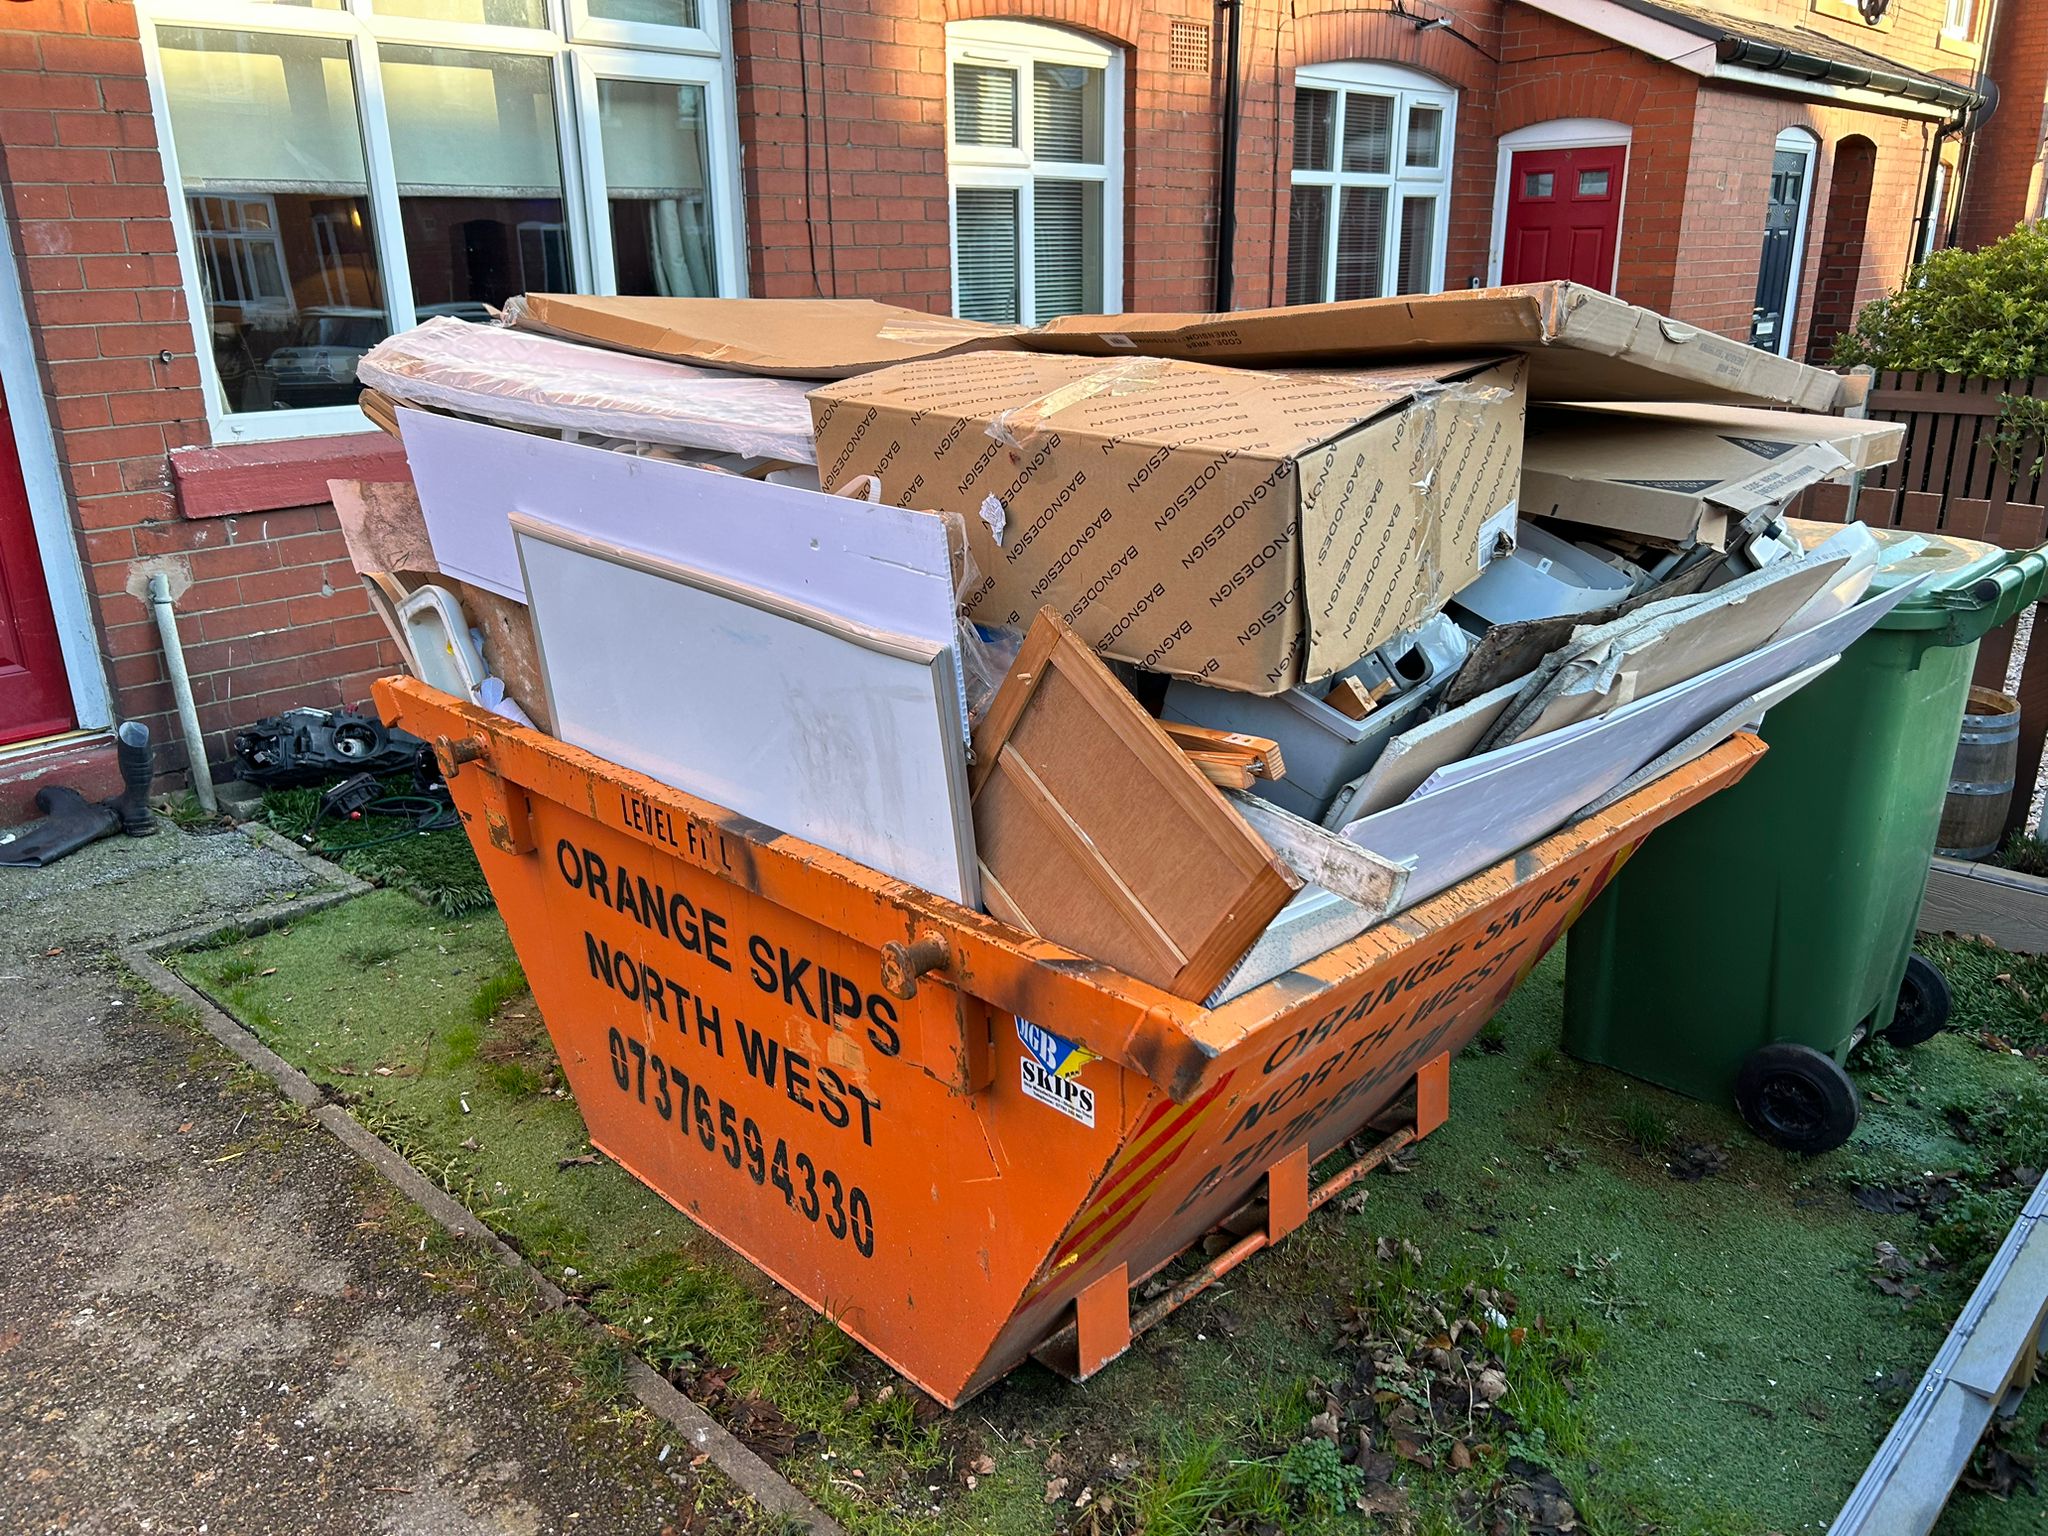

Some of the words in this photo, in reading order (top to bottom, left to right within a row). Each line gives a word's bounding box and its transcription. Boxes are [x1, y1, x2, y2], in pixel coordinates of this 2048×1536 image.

[1089, 402, 1240, 428] BAGNODESIGN
[1452, 421, 1502, 545] BAGNODESIGN
[1006, 470, 1087, 565] BAGNODESIGN
[1030, 507, 1113, 600] BAGNODESIGN
[1323, 478, 1384, 618] BAGNODESIGN
[1342, 503, 1401, 639] BAGNODESIGN
[620, 793, 678, 847] LEVEL
[687, 821, 731, 871] FIL
[556, 838, 733, 973] ORANGE
[748, 934, 901, 1057] SKIPS
[1263, 942, 1466, 1075] ORANGE
[1474, 866, 1591, 951] SKIPS
[584, 930, 725, 1058] NORTH
[735, 1018, 881, 1147] WEST
[1022, 1060, 1092, 1112] SKIPS
[1222, 1013, 1405, 1144] NORTH
[1406, 937, 1528, 1032] WEST
[608, 1026, 874, 1259] 07376594330
